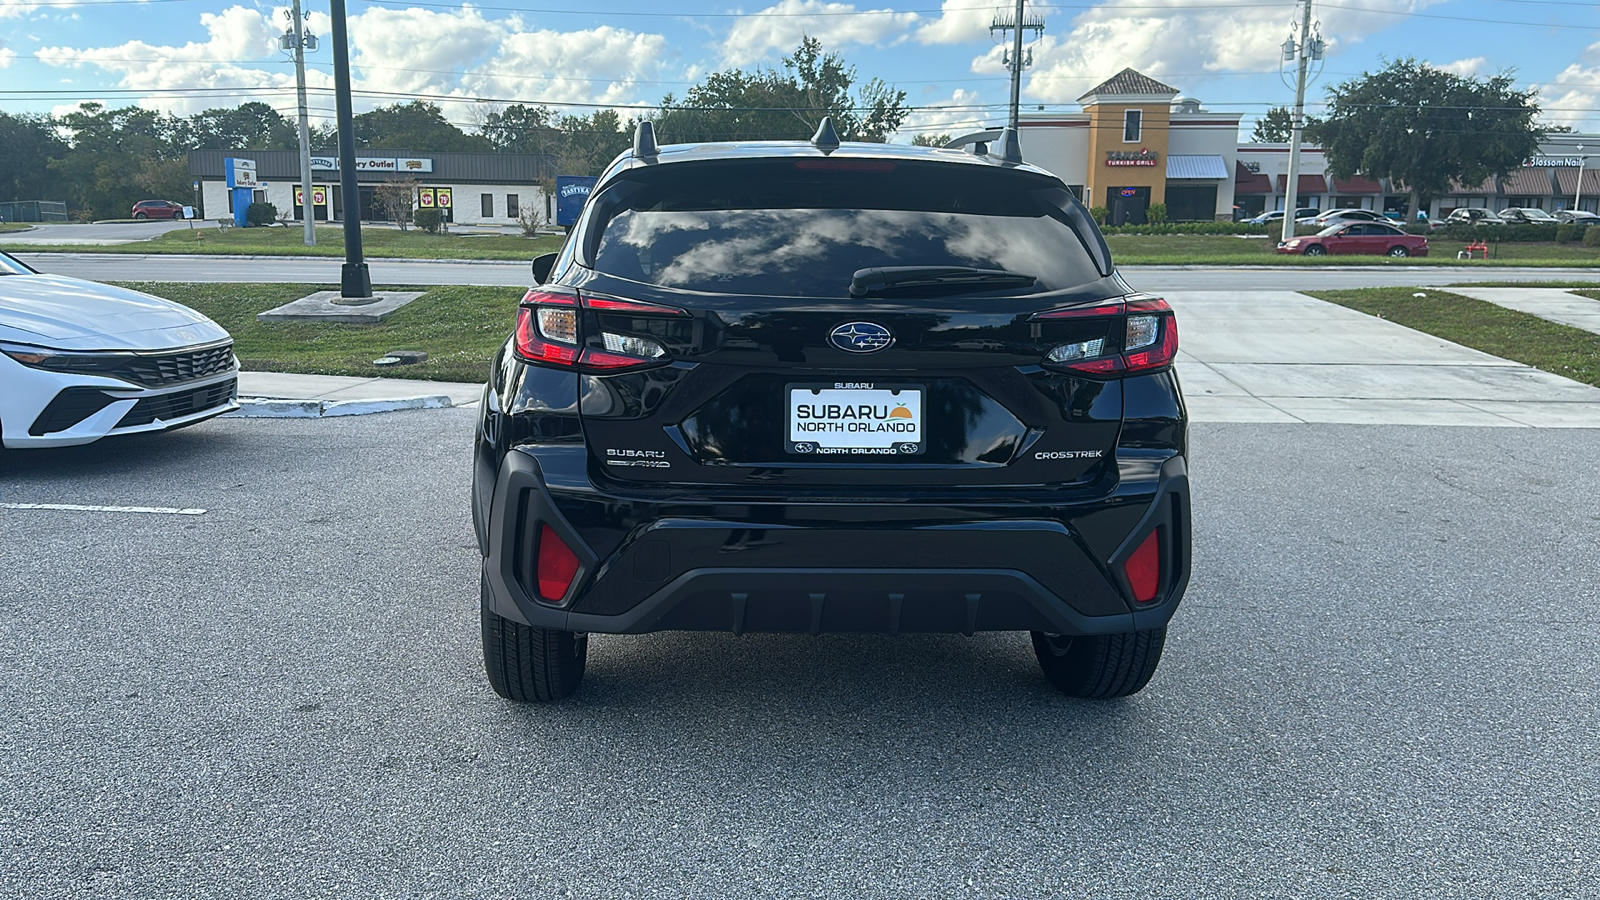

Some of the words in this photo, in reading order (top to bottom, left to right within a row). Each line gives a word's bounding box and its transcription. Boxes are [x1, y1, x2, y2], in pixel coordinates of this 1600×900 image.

[369, 160, 394, 168] Outlet
[1530, 156, 1563, 167] Blossom
[562, 187, 591, 197] TASTYKA
[797, 404, 888, 419] SUBARU
[797, 422, 844, 432] NORTH
[847, 422, 916, 433] ORLANDO
[606, 448, 665, 458] SUBARU
[1034, 449, 1103, 460] CROSSTREK
